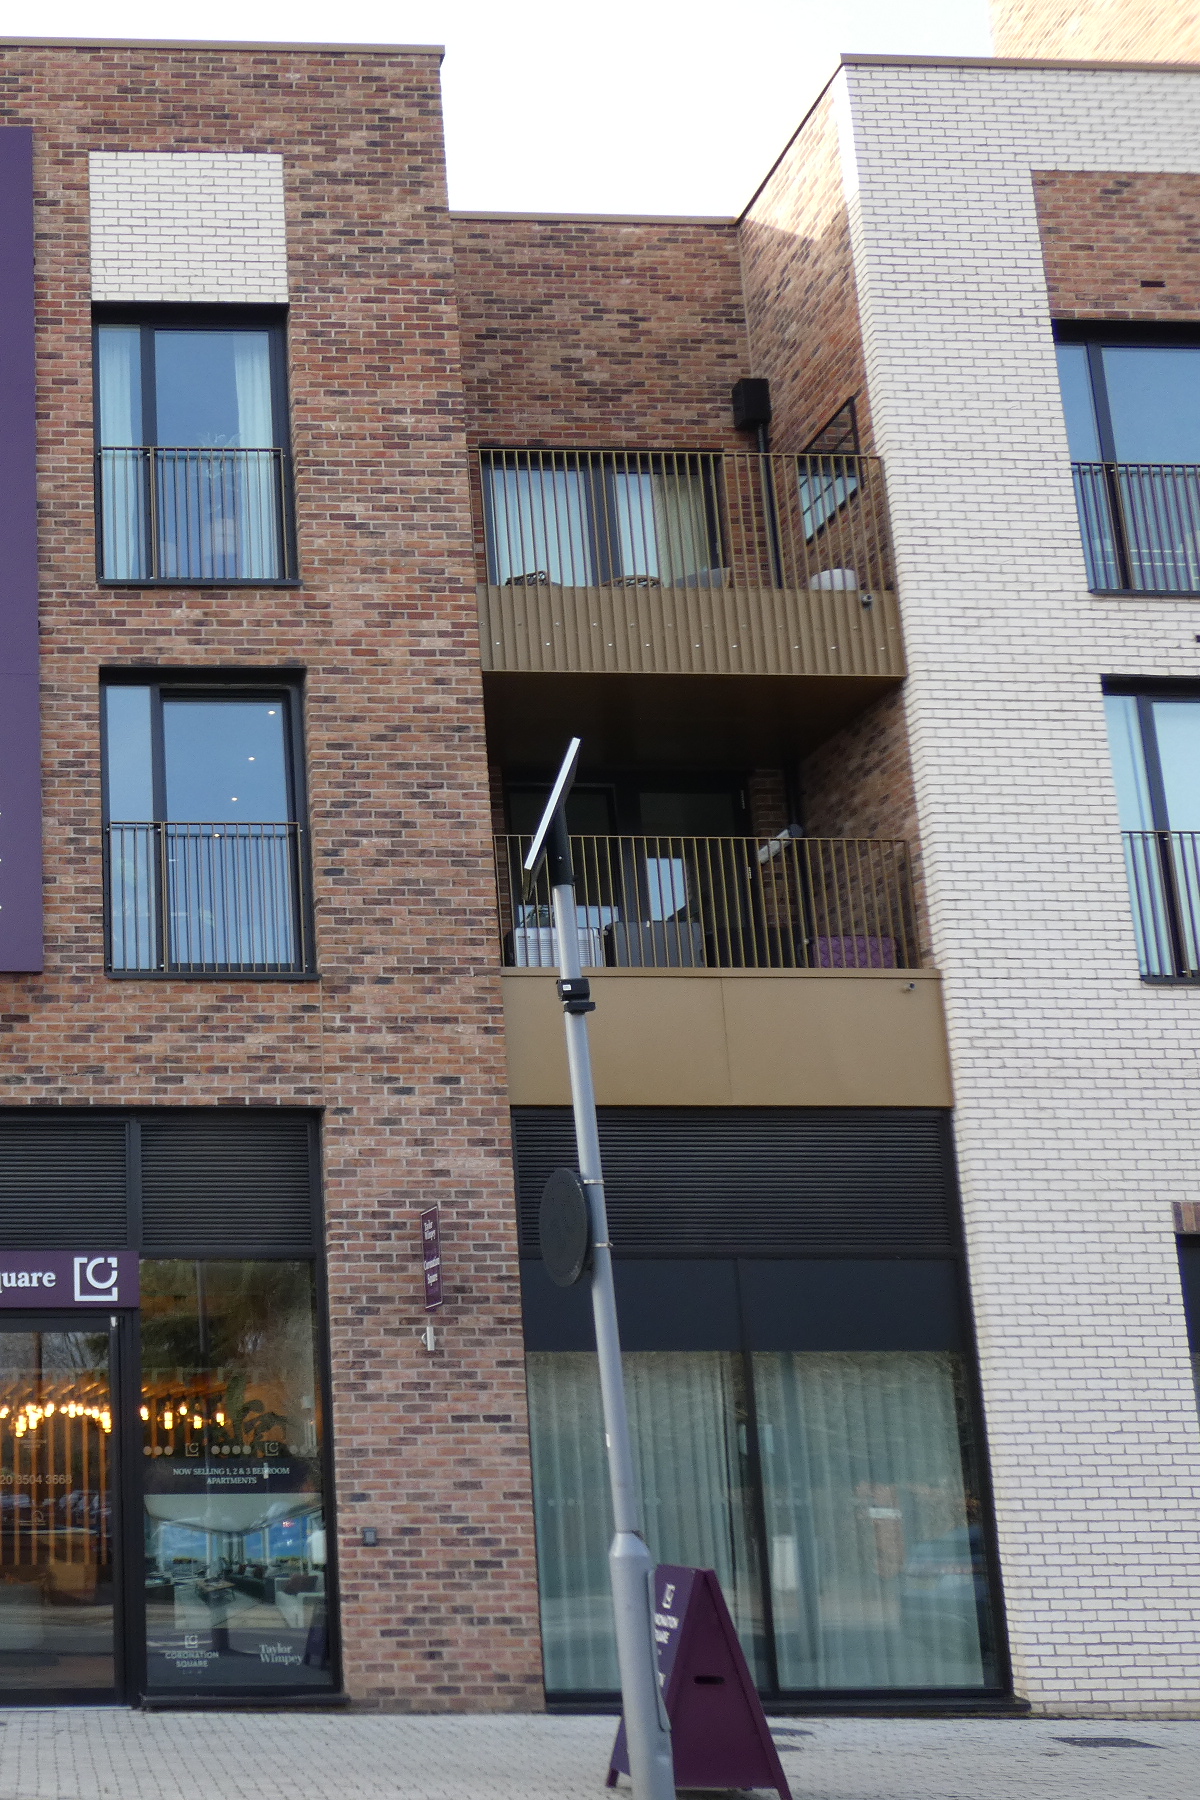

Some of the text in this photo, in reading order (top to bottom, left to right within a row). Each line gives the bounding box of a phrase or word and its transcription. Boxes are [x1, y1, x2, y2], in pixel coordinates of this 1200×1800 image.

[173, 1468, 191, 1476] NOW
[193, 1467, 225, 1476] SELLING
[226, 1467, 232, 1477] 1,
[233, 1467, 238, 1475] 2
[239, 1467, 245, 1475] &
[246, 1467, 251, 1475] 3
[207, 1476, 257, 1485] APARTMENTS
[259, 1642, 293, 1655] Taylor
[164, 1650, 219, 1659] CORONATION
[175, 1660, 209, 1668] SQUARE
[260, 1653, 301, 1666] Wimpey
